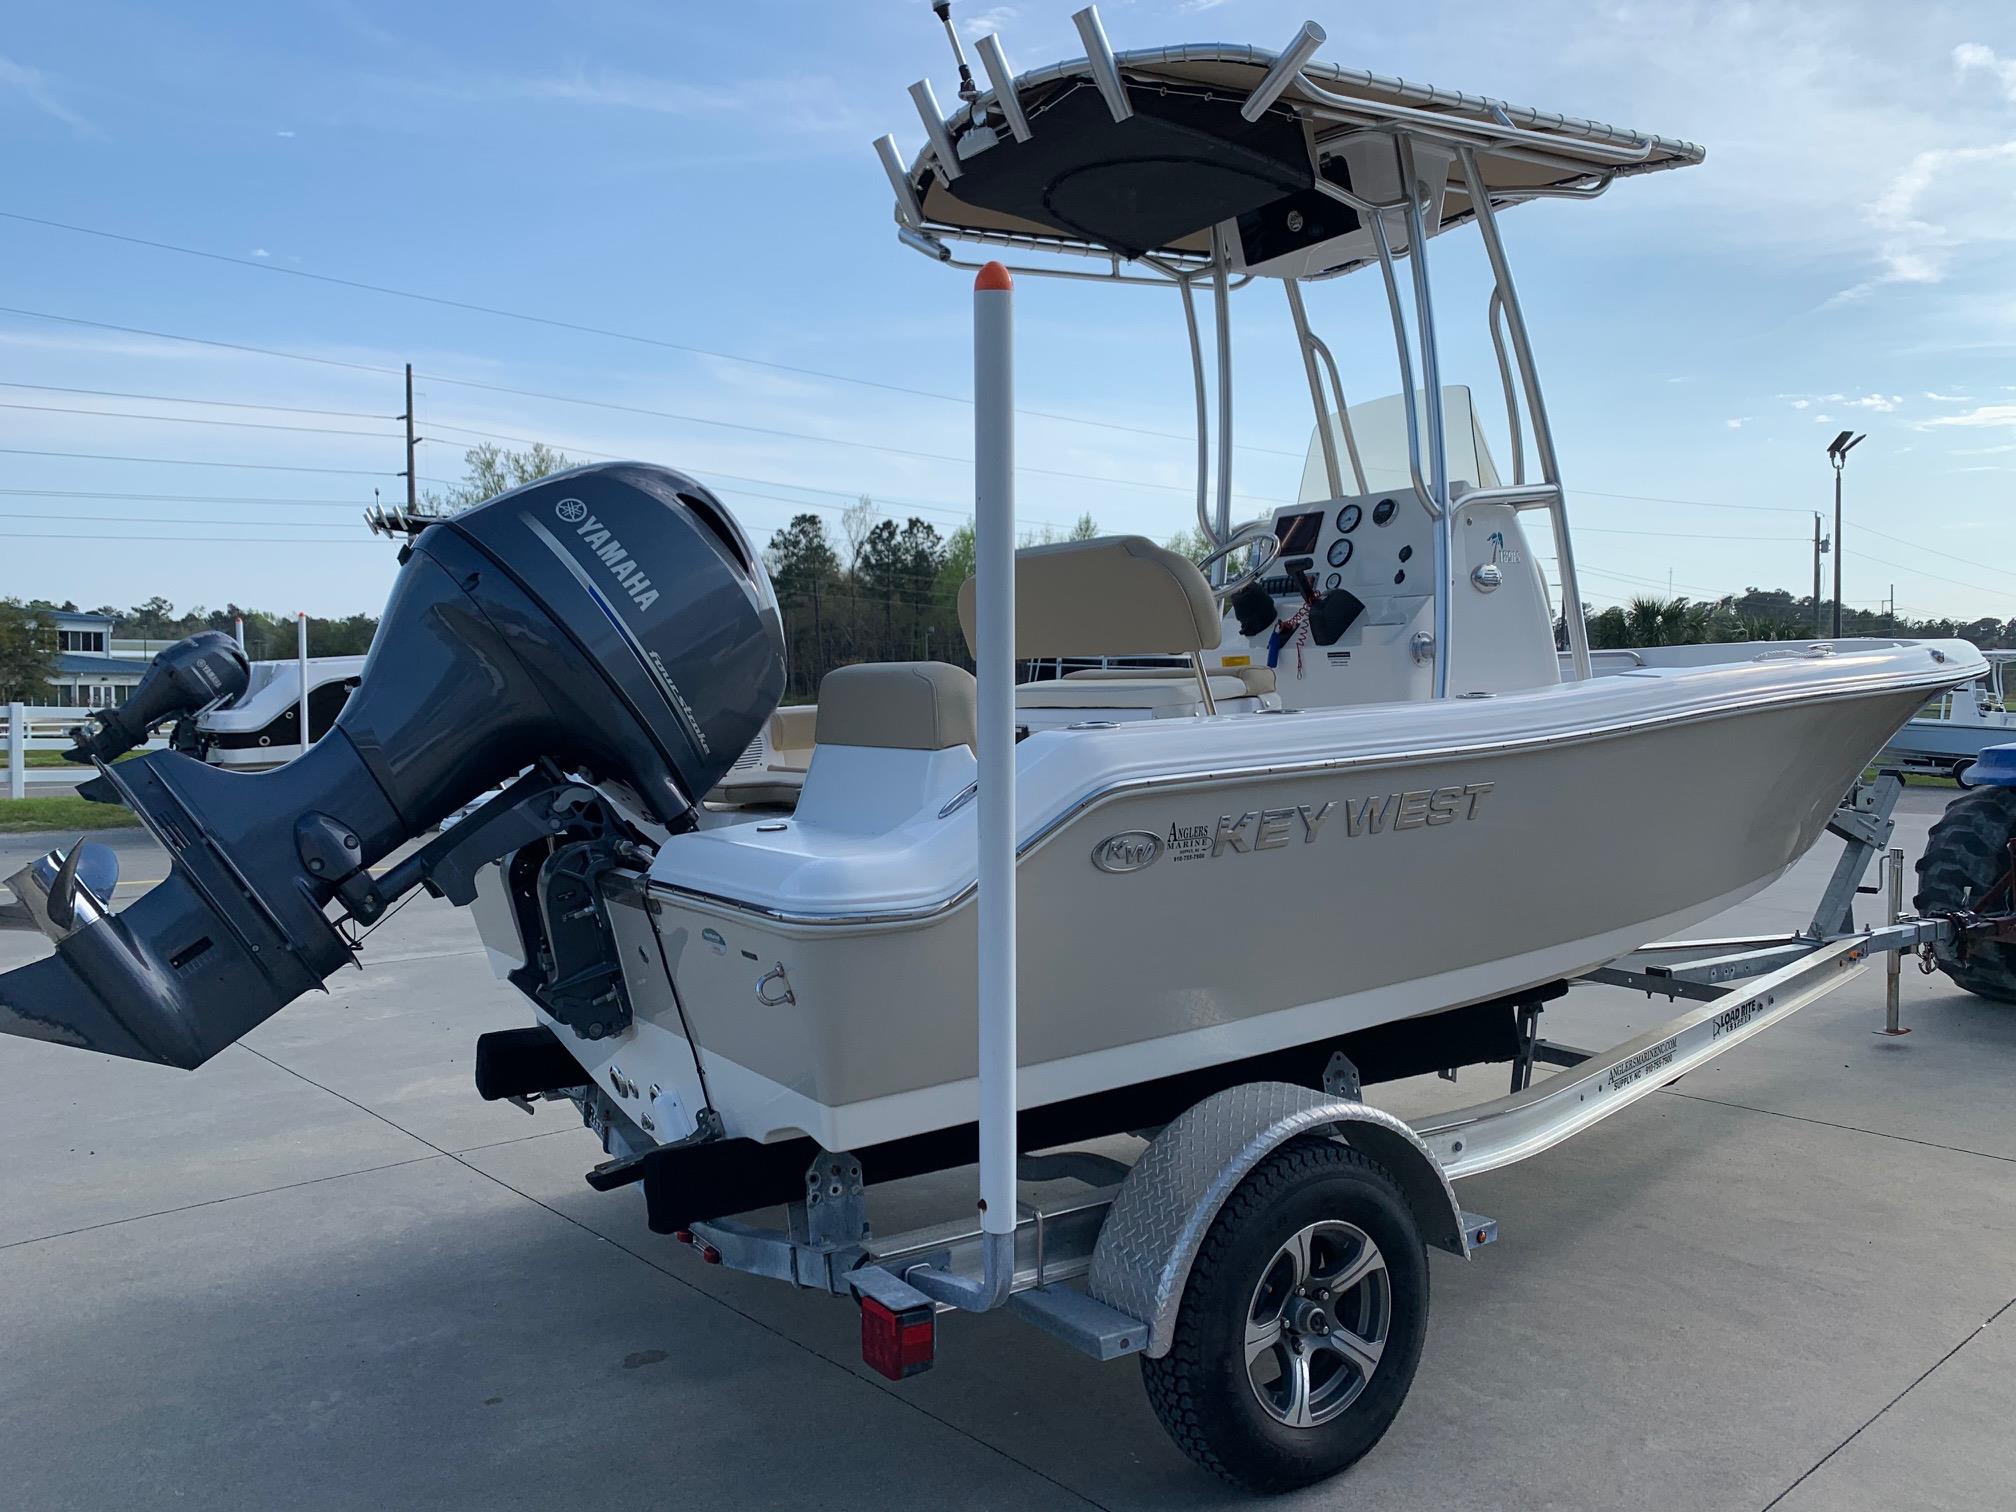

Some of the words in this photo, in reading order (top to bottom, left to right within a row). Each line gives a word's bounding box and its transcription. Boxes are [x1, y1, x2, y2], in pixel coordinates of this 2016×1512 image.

[577, 515, 660, 612] YAMAHA
[1167, 821, 1209, 843] ANGLERS
[1211, 801, 1339, 857] KEY
[1345, 781, 1496, 838] WEST
[1106, 839, 1154, 865] KW
[1167, 839, 1208, 850] MARINE
[1720, 1007, 1740, 1028] LOAD
[1740, 999, 1756, 1017] RITE
